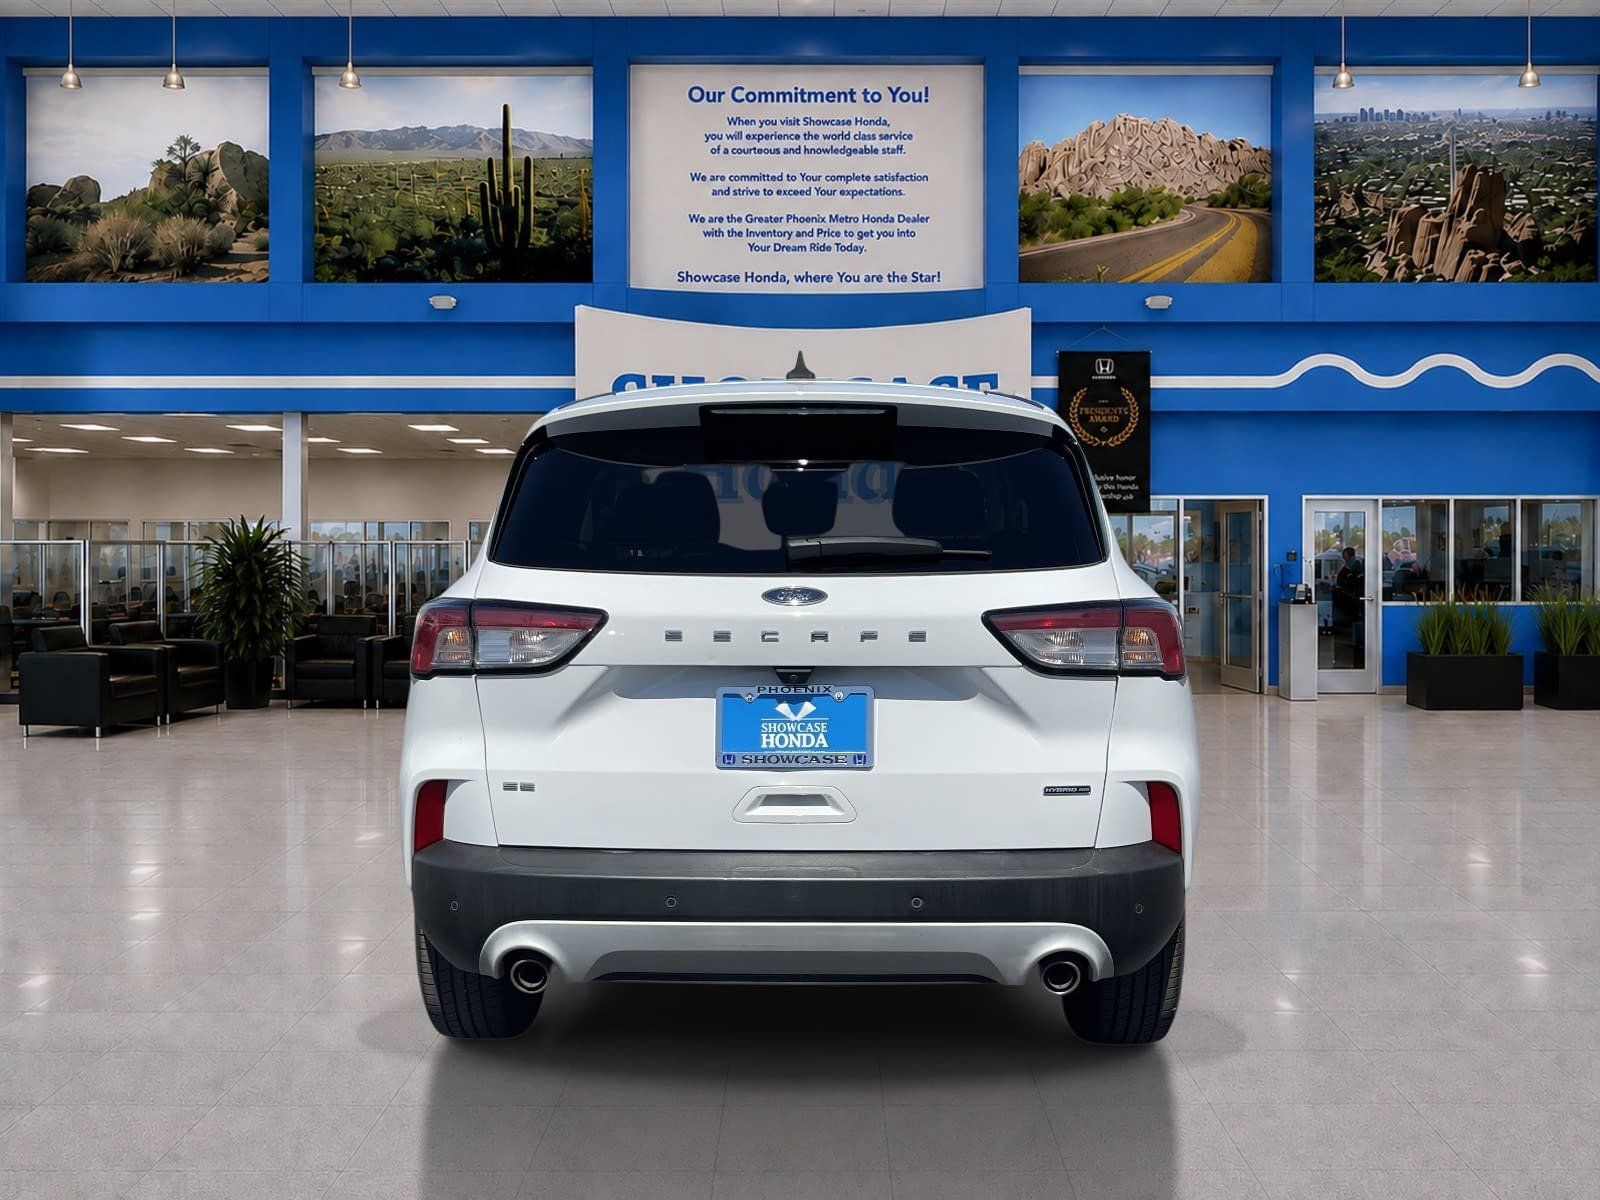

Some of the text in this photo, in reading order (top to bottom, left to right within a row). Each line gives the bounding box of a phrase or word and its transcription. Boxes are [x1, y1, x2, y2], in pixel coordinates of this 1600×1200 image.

[688, 86, 930, 103] Our Commitment to You!
[727, 117, 890, 129] When you visit Showcase Honda,
[704, 131, 914, 143] you will experience the world class service
[710, 145, 721, 155] of
[731, 146, 780, 155] courteous
[783, 145, 801, 155] and
[881, 145, 906, 155] staff.
[690, 172, 707, 182] We
[729, 172, 783, 182] committed
[786, 173, 797, 182] to
[800, 172, 822, 182] Your
[825, 172, 871, 184] complete
[874, 172, 928, 182] satisfaction
[712, 187, 906, 199] and strive to exceed Your expectations.
[689, 214, 706, 224] We
[726, 214, 743, 224] the
[745, 214, 783, 224] Greater
[786, 214, 826, 224] Phoenix
[829, 214, 859, 224] Metro
[862, 214, 895, 224] Honda
[897, 214, 930, 224] Dealer
[703, 228, 916, 240] with the Inventory and Price to get you into
[748, 243, 867, 254] Your Dream Ride Today.
[677, 271, 941, 286] Showcase Honda, where You are the Star!
[777, 590, 811, 601] Ford
[665, 630, 927, 643] ESCAPE
[757, 686, 832, 694] PHOENIX
[761, 722, 828, 733] SHOWCASE
[761, 733, 829, 748] HONDA
[742, 754, 848, 765] SHOWCASE
